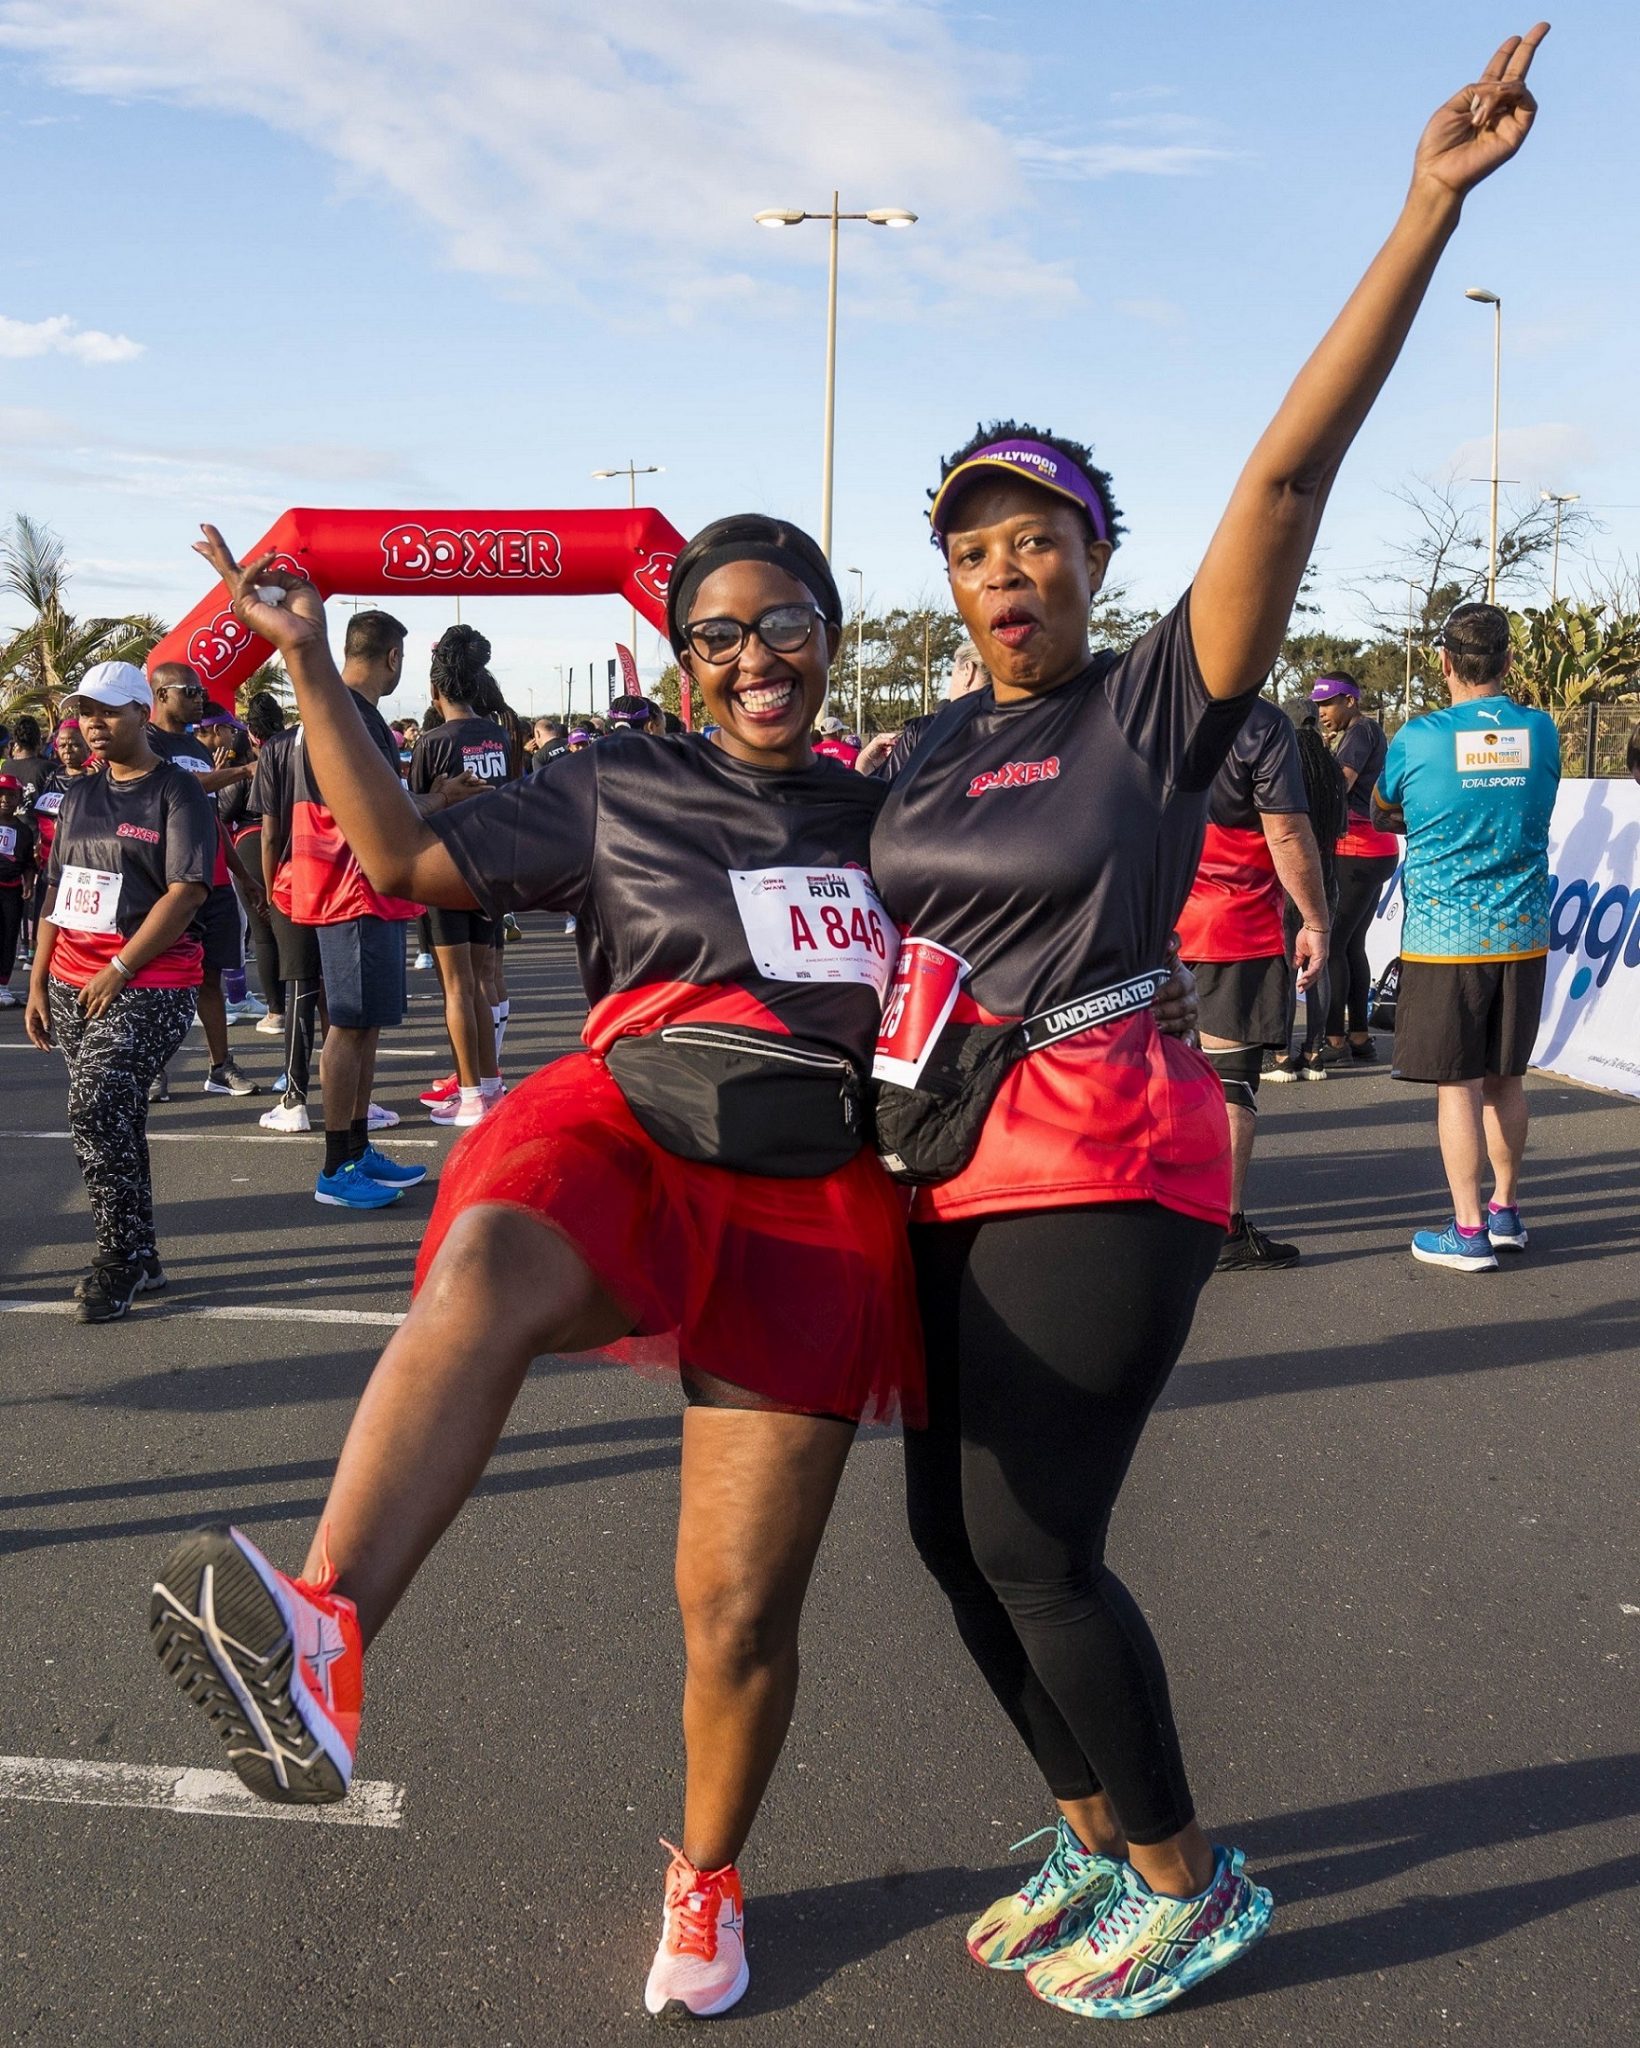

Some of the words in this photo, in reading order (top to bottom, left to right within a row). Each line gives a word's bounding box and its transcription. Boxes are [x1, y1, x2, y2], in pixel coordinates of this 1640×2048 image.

[381, 523, 562, 581] BOXER
[463, 753, 507, 780] RUN
[1466, 752, 1498, 765] RUN
[1462, 776, 1526, 789] TOTALSPORTS
[116, 822, 160, 844] BOXER
[65, 887, 73, 911] A
[74, 888, 101, 915] 983
[809, 882, 850, 899] RUN
[789, 905, 818, 951] A
[820, 905, 886, 960] 846
[1045, 980, 1155, 1034] UNDERRATED
